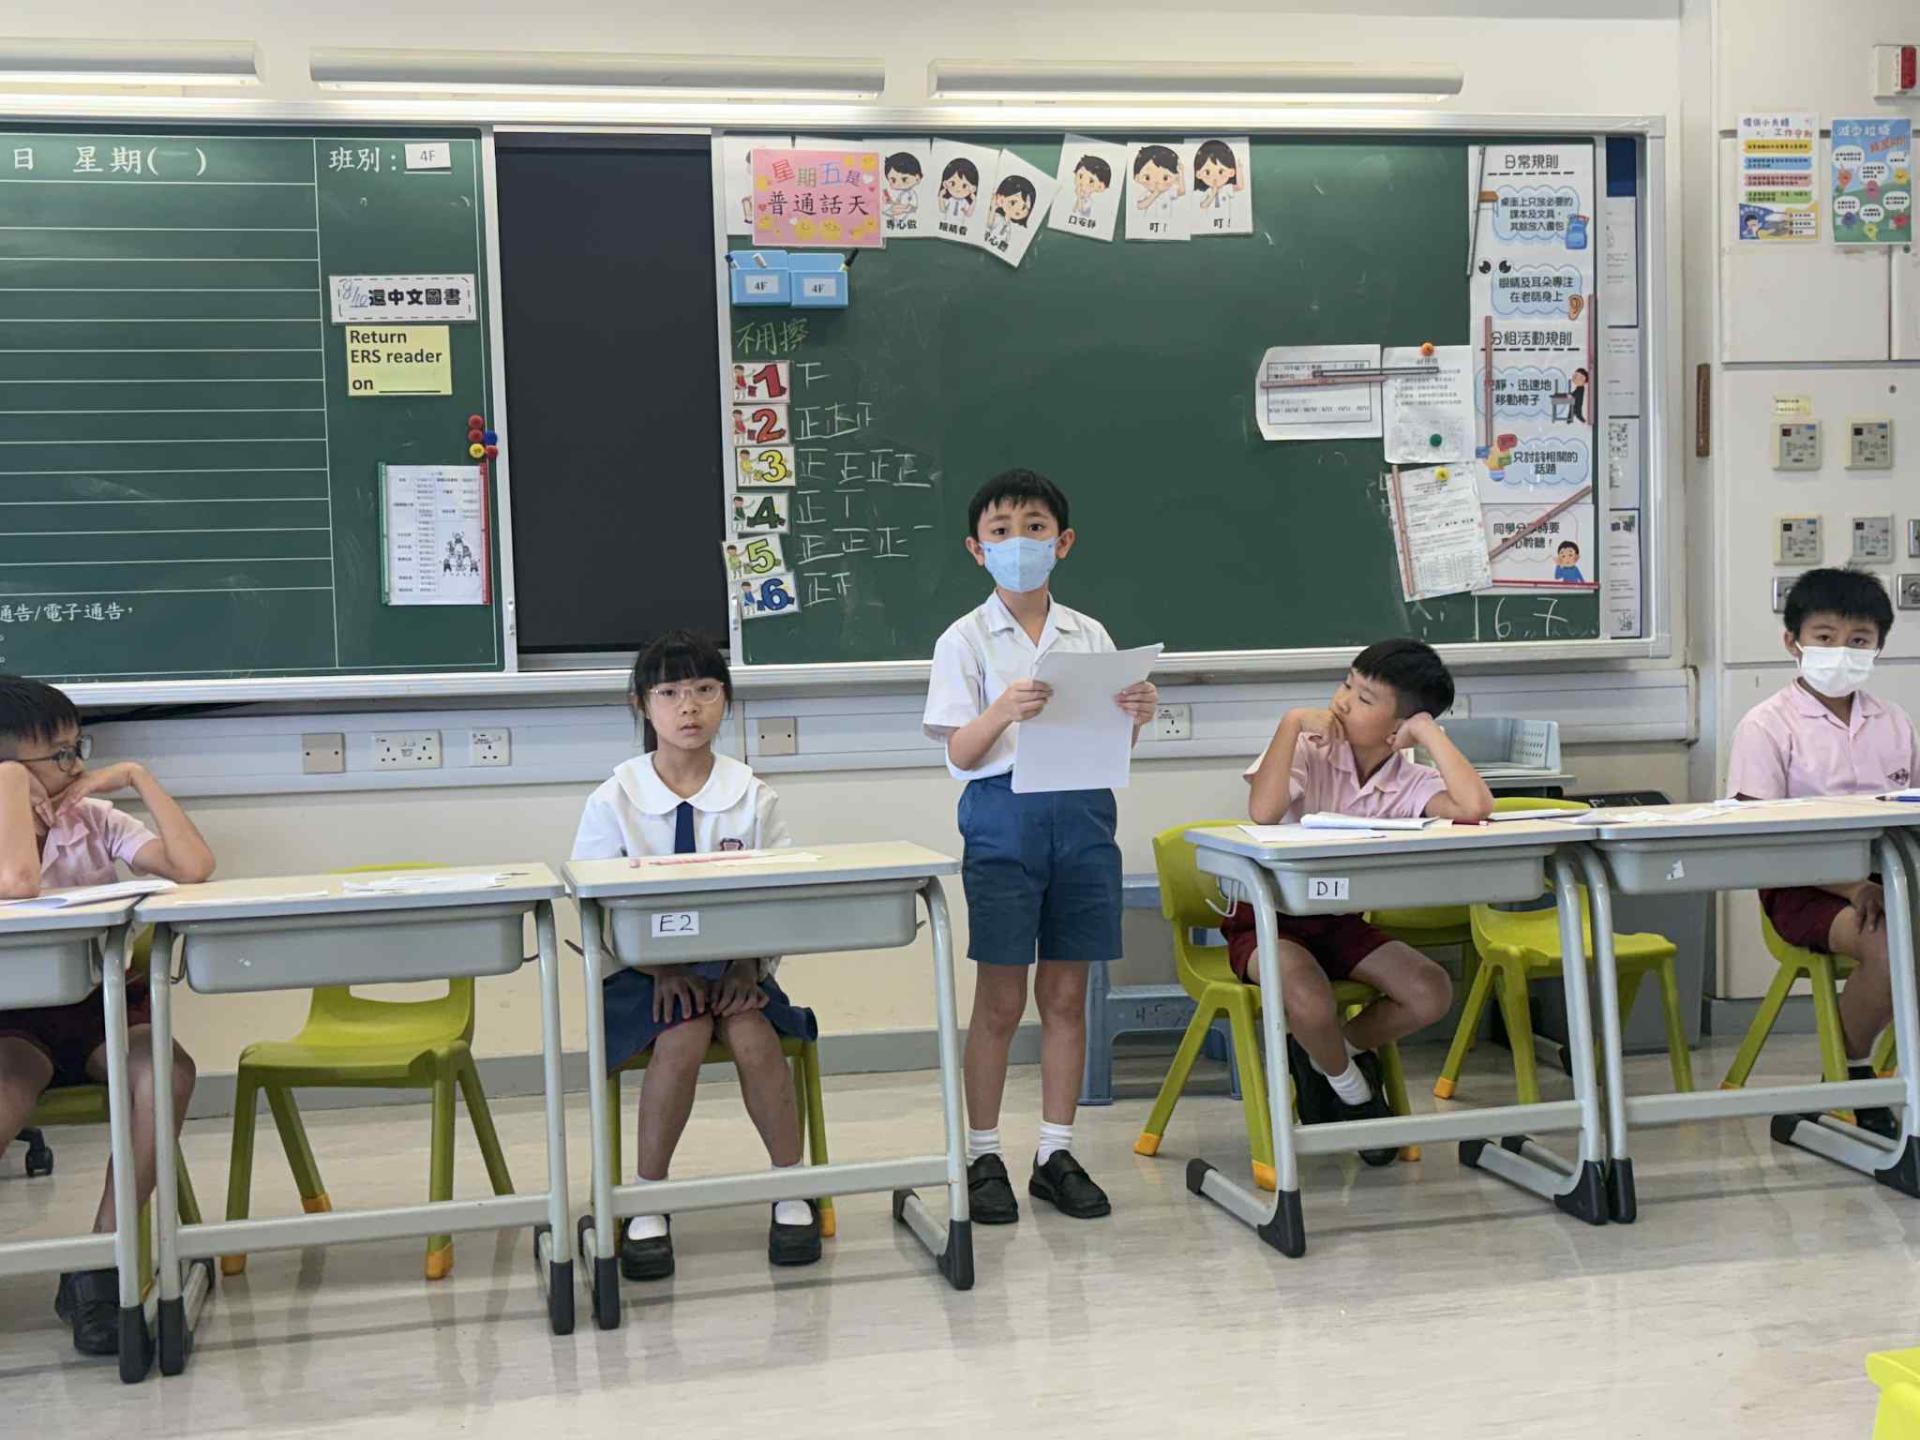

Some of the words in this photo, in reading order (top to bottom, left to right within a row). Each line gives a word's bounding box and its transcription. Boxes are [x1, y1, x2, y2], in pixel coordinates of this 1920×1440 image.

[14, 147, 34, 170] 日
[420, 150, 436, 162] 4F
[1504, 154, 1560, 169] 日常規則
[768, 191, 869, 216] 普通話天
[754, 280, 768, 291] 4F
[811, 283, 825, 294] 4F
[350, 330, 407, 344] Return
[1491, 331, 1573, 345] 分組活動規則
[351, 350, 382, 363] ERS
[386, 349, 442, 363] reader
[352, 380, 374, 390] on
[1316, 880, 1339, 897] D1
[659, 914, 694, 932] E2
